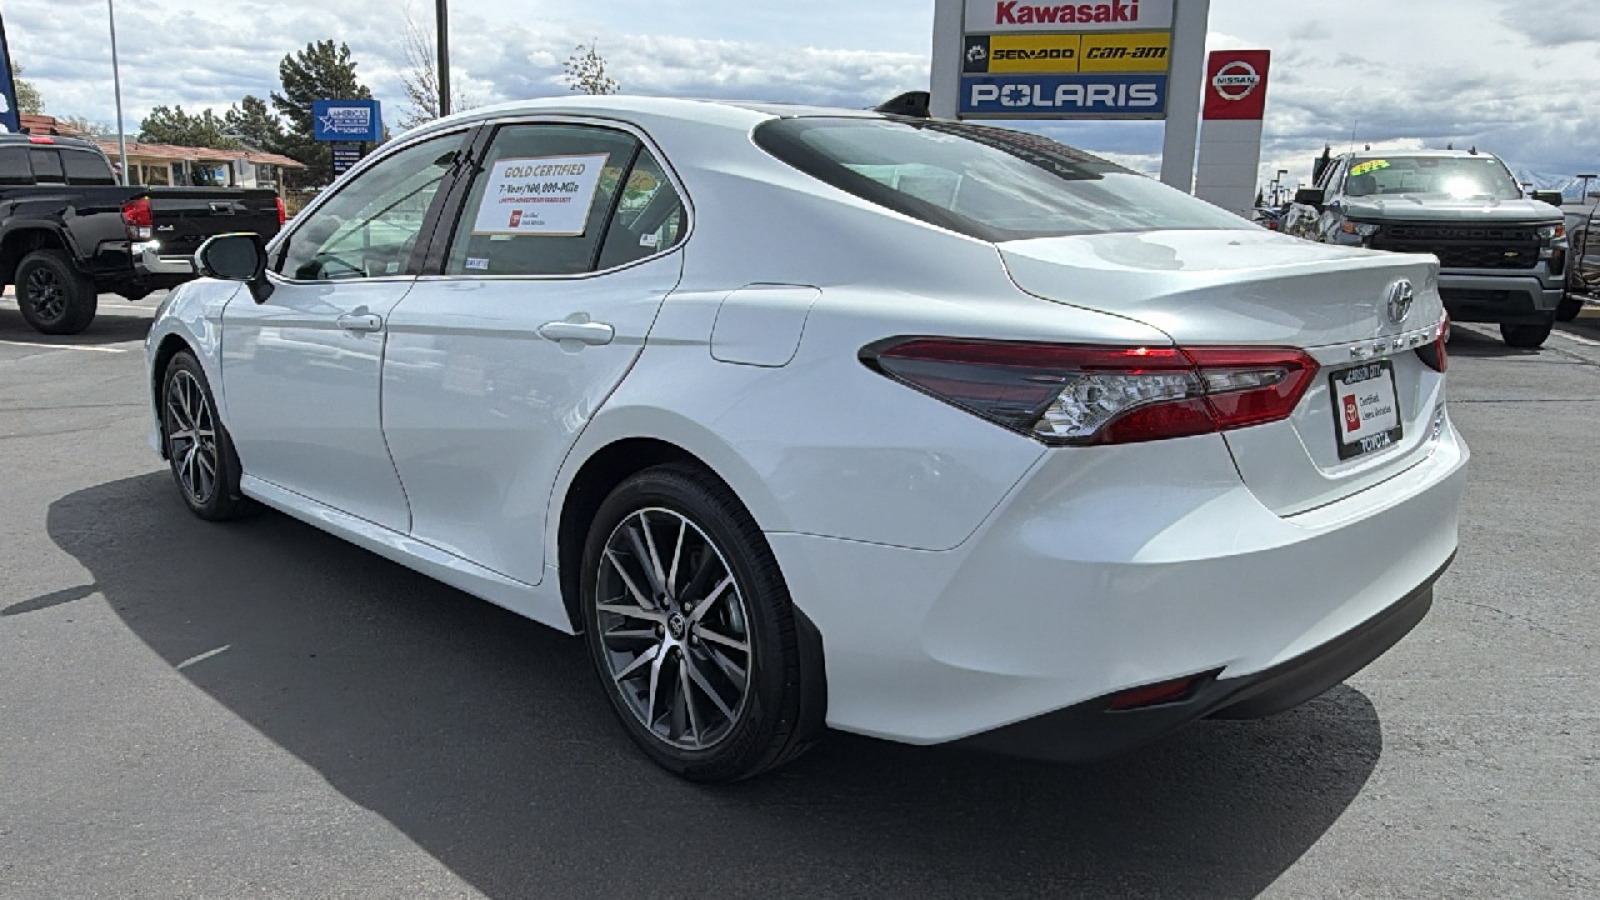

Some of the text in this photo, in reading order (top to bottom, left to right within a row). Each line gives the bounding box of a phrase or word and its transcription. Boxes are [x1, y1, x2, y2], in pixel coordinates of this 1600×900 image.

[995, 0, 1139, 25] Kawasaki
[970, 83, 1158, 107] POLARIS
[505, 163, 586, 178] GOLD CERTIFIED
[1360, 431, 1391, 453] TOYOTA
